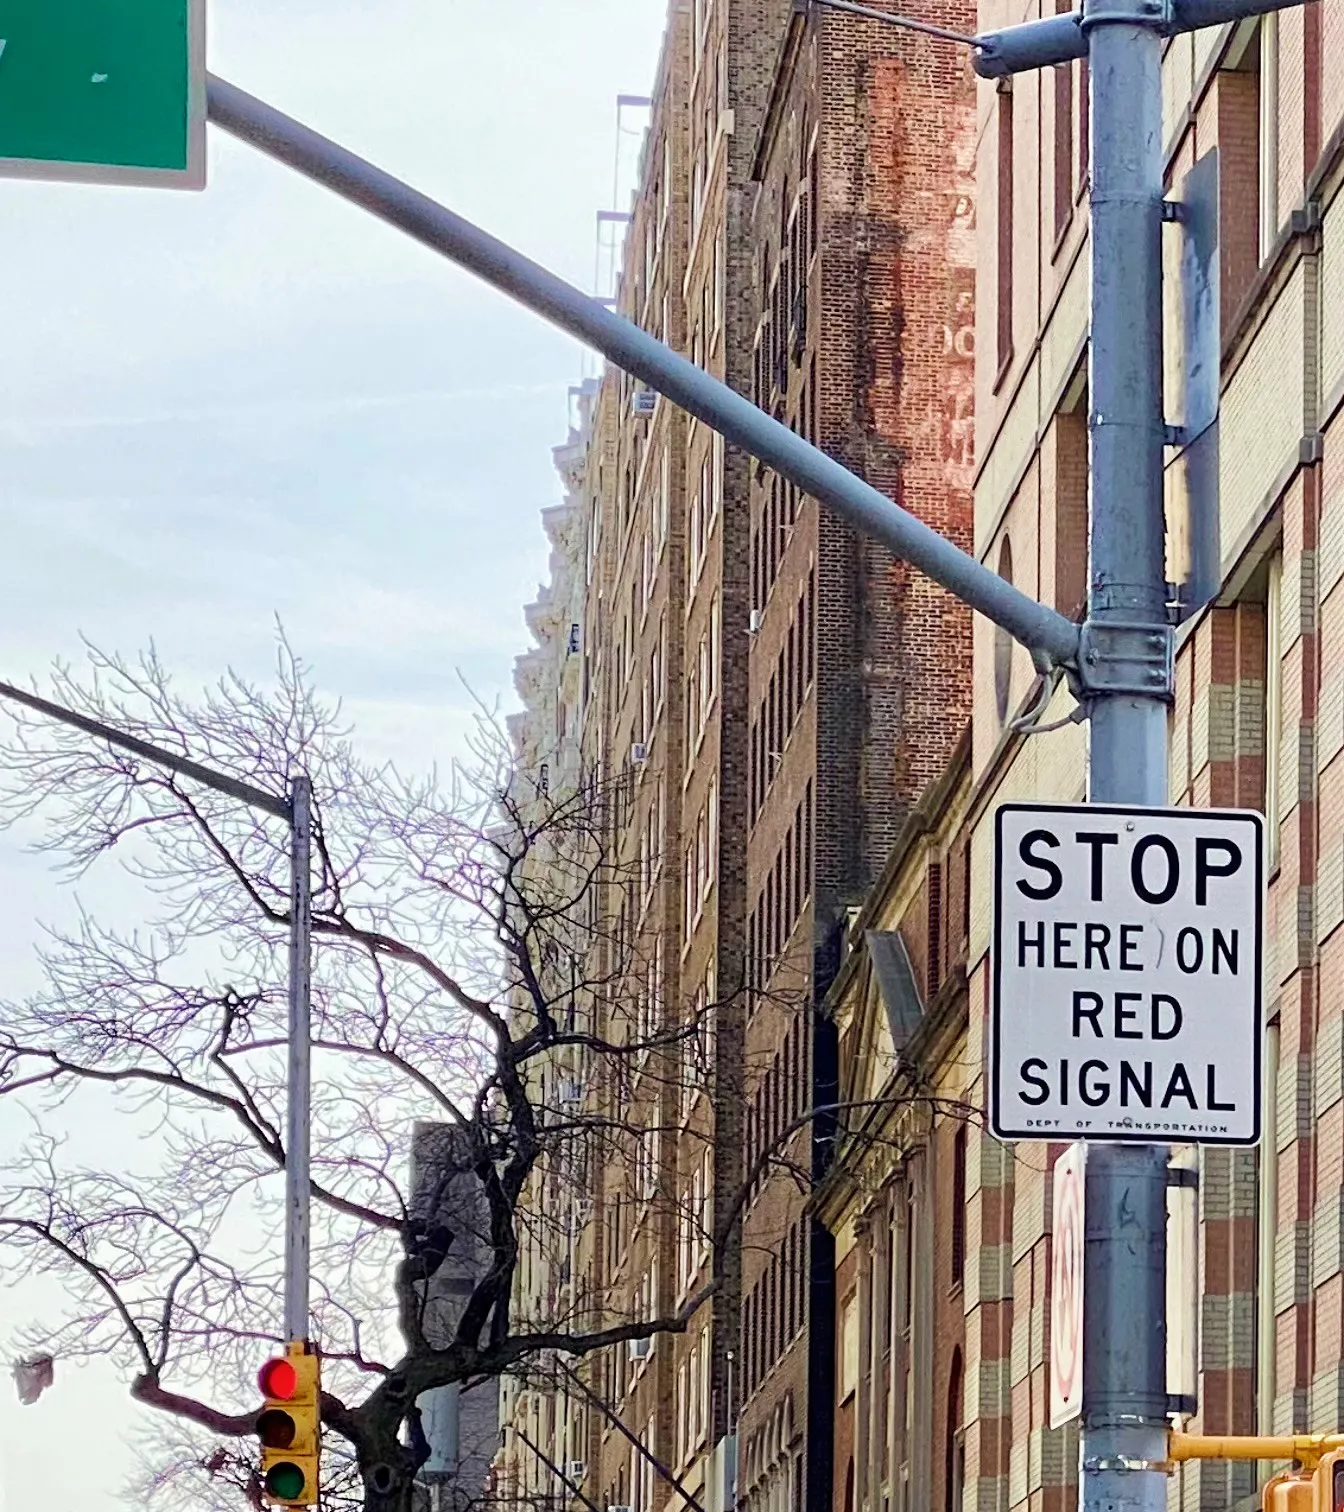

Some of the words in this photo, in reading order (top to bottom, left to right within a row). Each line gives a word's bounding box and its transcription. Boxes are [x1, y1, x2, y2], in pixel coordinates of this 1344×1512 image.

[1015, 829, 1242, 906] STOP
[1017, 921, 1144, 971] HERE
[1176, 926, 1239, 975] ON
[1072, 991, 1183, 1040] RED
[1018, 1058, 1236, 1112] SIGNAL
[1026, 1119, 1060, 1128] DEPT
[1075, 1120, 1092, 1128] OF
[1108, 1120, 1229, 1134] TRANSPORTATION
